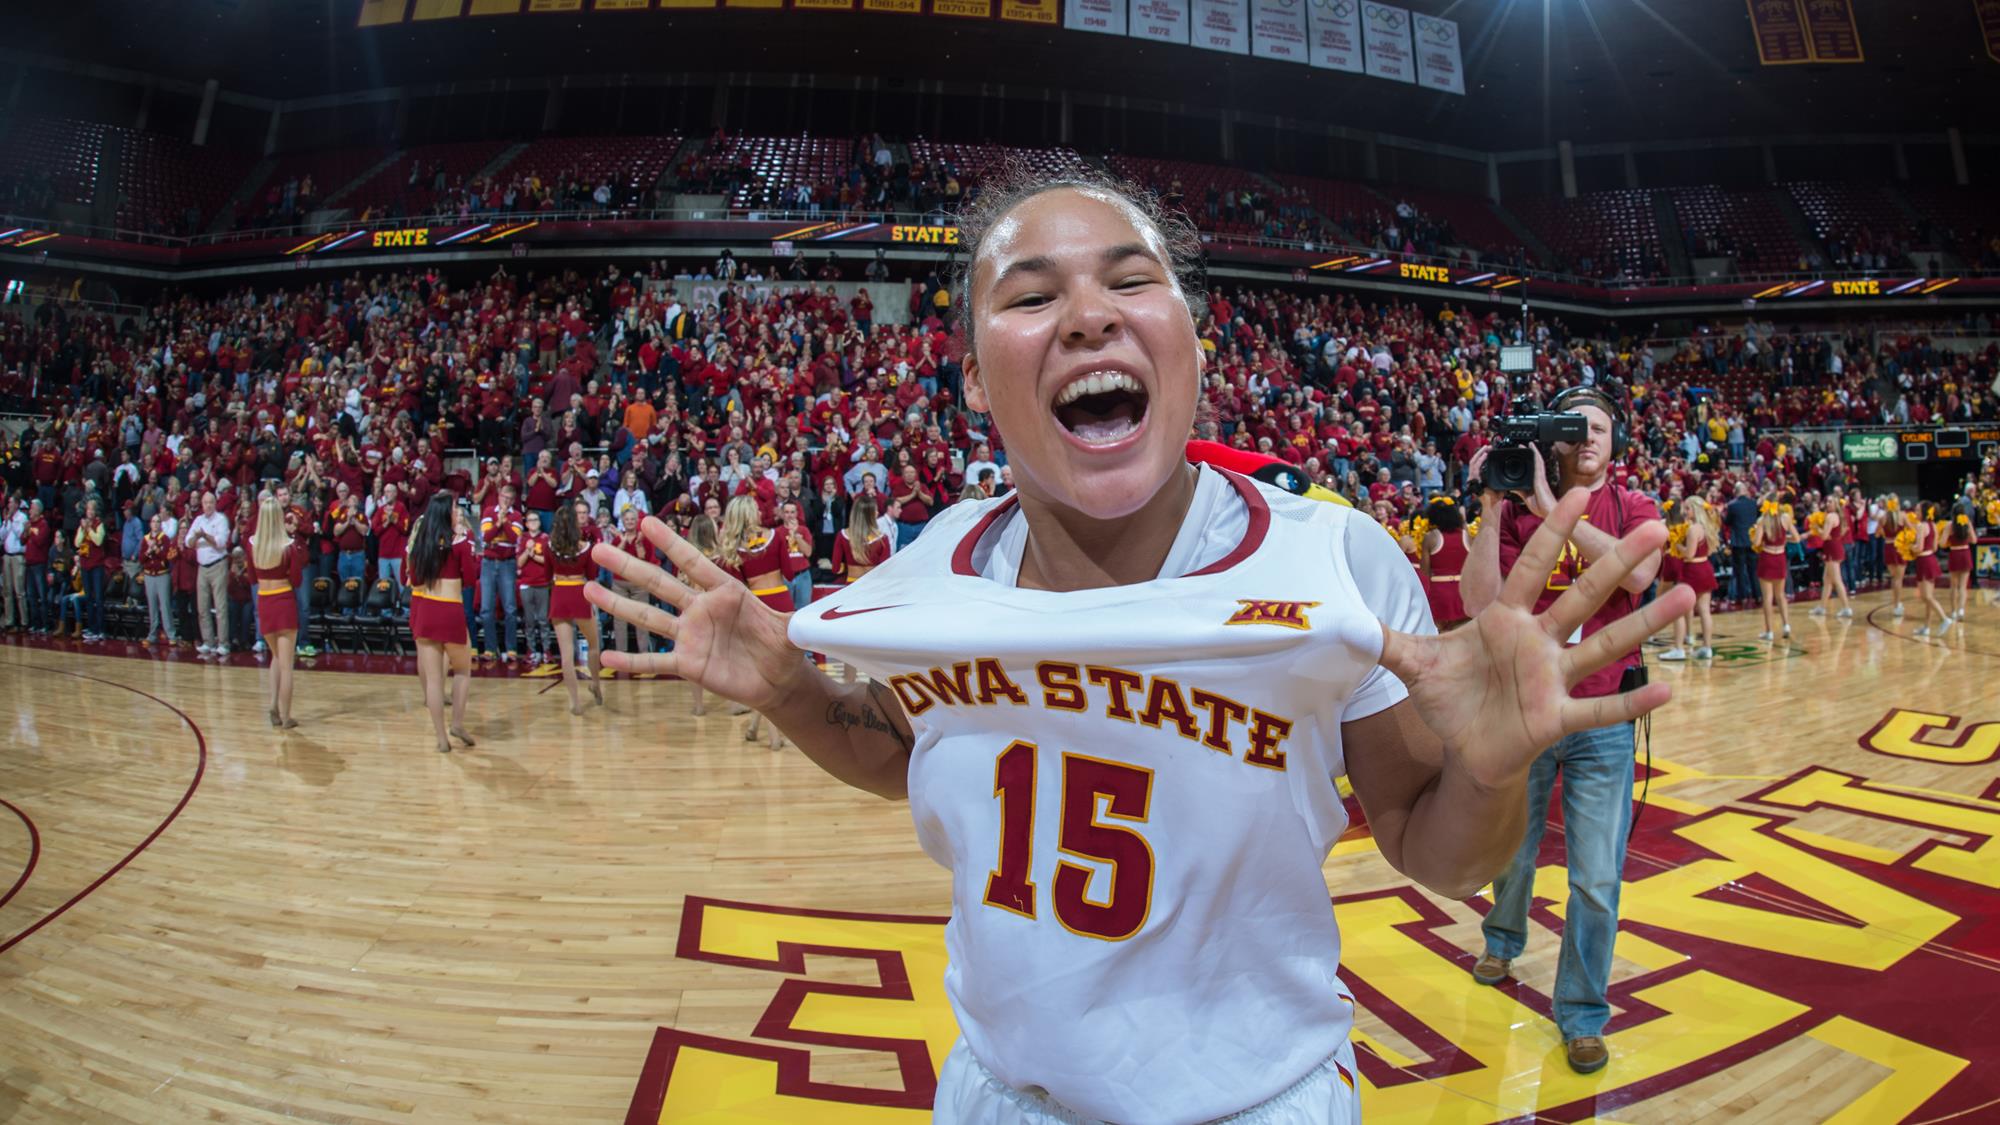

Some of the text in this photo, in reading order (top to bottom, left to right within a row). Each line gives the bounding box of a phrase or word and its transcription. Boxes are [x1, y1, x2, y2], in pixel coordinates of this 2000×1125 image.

[373, 228, 429, 247] STATE
[891, 225, 960, 245] STATE
[1400, 262, 1449, 283] STATE
[1832, 279, 1880, 295] STATE
[1901, 432, 1933, 443] CYCLONES
[1223, 599, 1321, 630] XII
[887, 657, 1294, 772] OWA STATE
[982, 738, 1156, 943] 15
